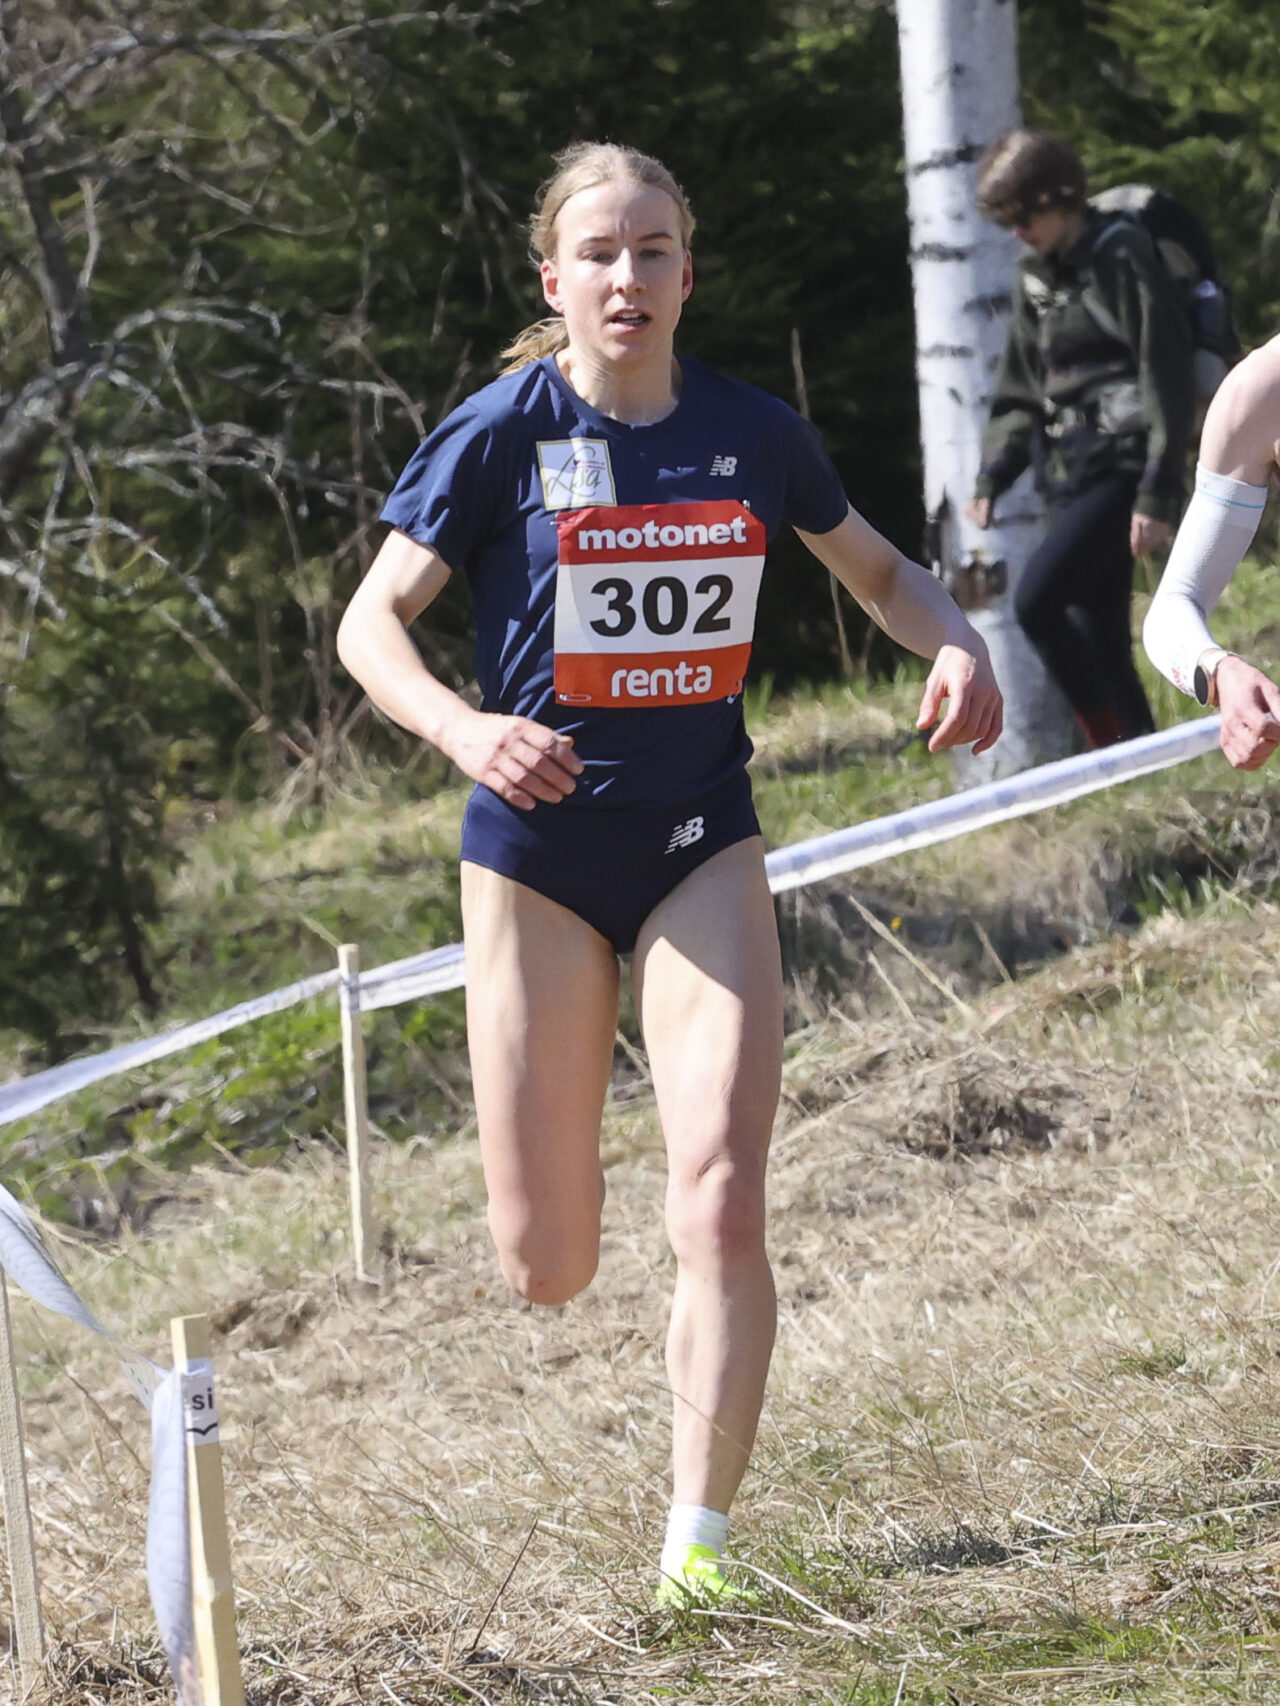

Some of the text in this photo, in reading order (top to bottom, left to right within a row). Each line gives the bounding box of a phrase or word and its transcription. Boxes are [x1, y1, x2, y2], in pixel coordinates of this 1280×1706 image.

[577, 515, 748, 551] motonet
[589, 574, 734, 638] 302
[610, 661, 713, 698] renta
